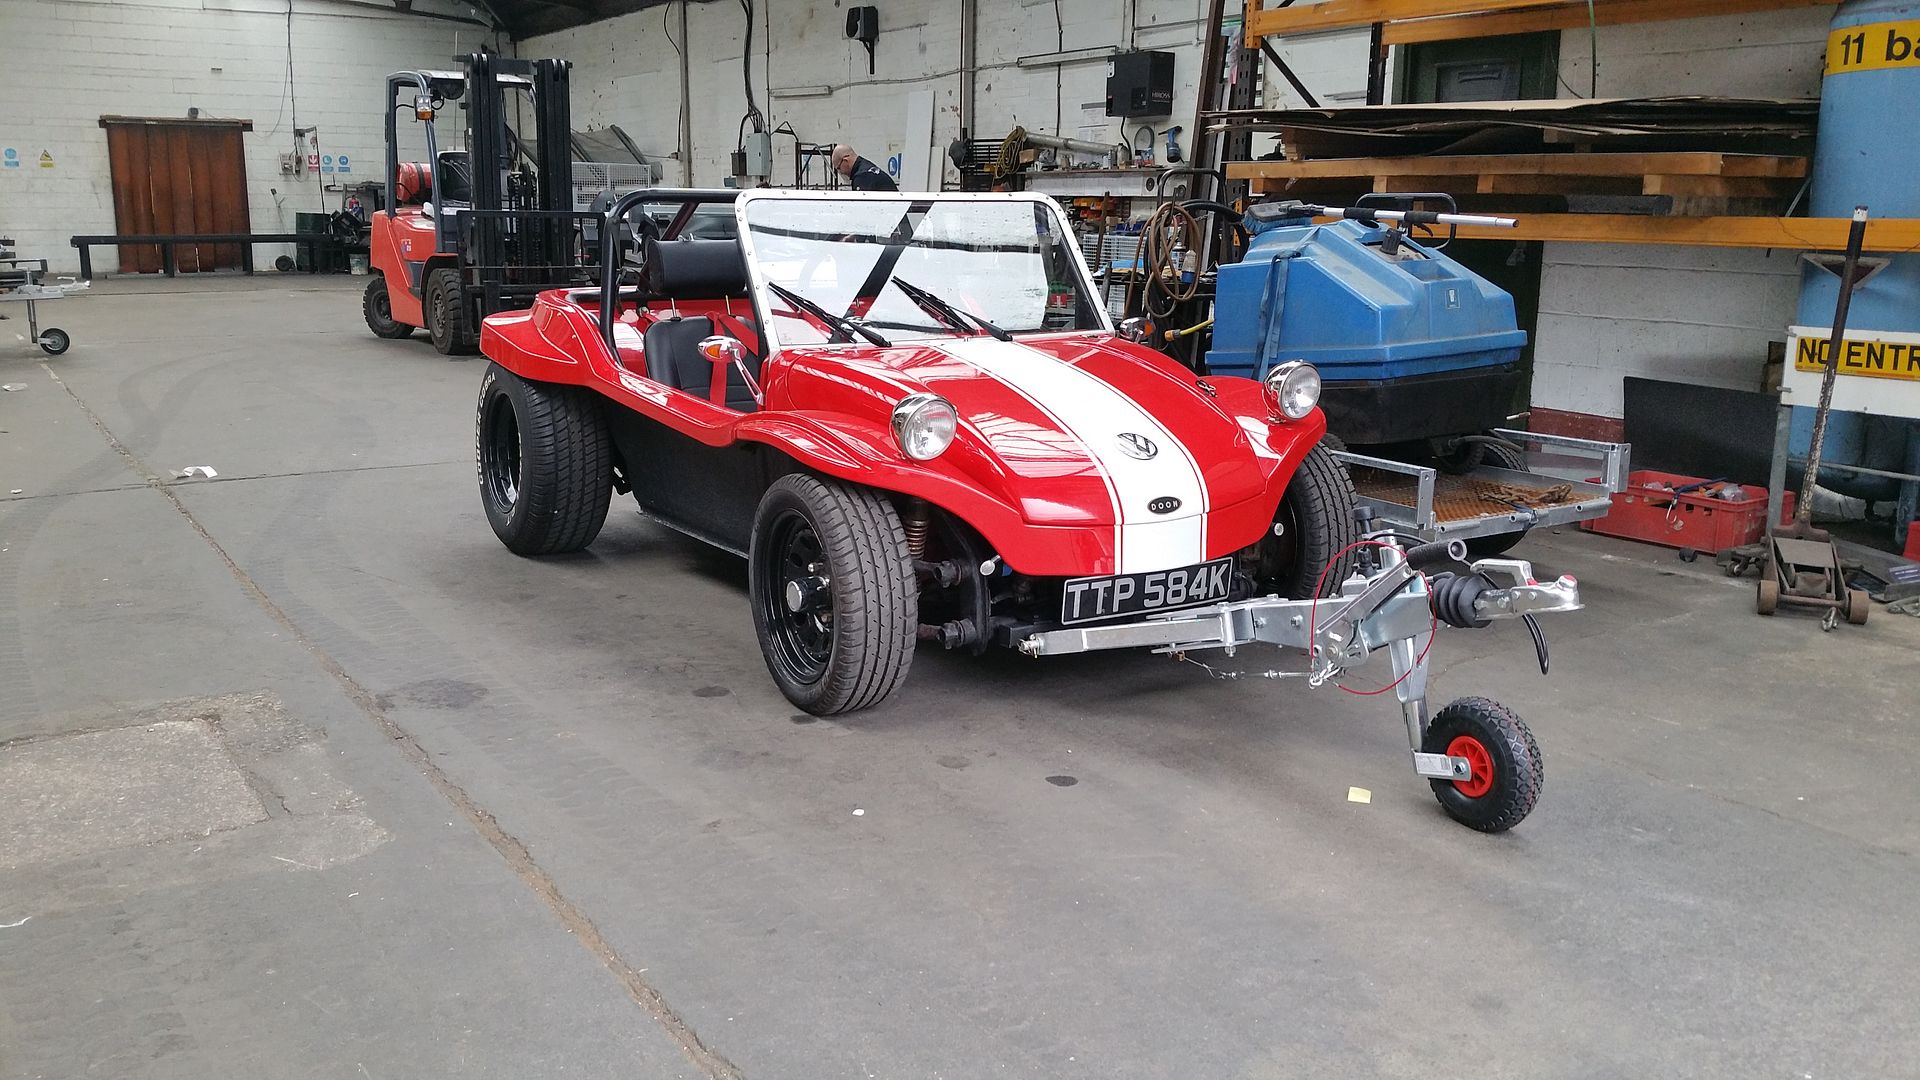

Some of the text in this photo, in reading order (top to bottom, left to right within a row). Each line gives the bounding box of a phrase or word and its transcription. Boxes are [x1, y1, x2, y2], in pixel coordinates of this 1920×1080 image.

[1841, 29, 1920, 65] 11 b
[1799, 338, 1920, 371] NO ENTR
[480, 372, 496, 408] COBRA
[1151, 500, 1178, 511] DOON
[1067, 563, 1229, 618] TTP 584K
